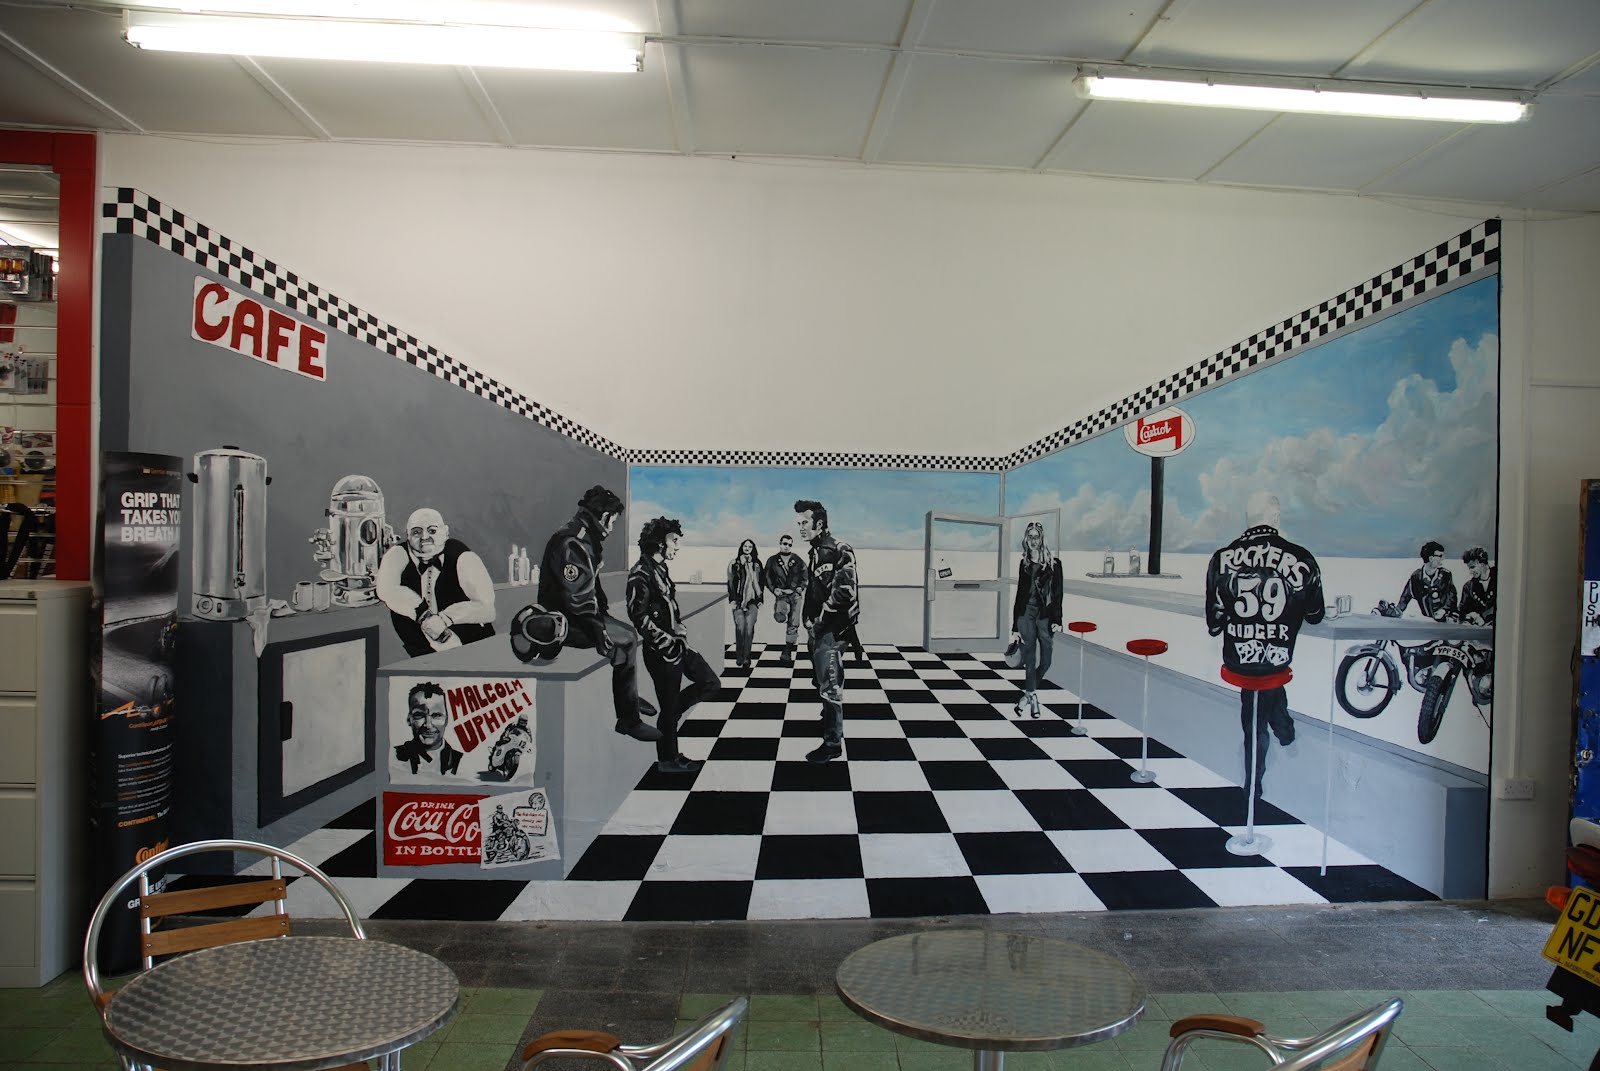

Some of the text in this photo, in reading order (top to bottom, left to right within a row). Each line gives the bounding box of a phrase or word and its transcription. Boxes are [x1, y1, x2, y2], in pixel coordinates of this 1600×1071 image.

[195, 283, 325, 378] CAFE
[1140, 421, 1172, 442] Castrol
[121, 492, 180, 508] GRIP THAT
[121, 509, 167, 524] TAKES
[121, 526, 174, 542] BREATH
[1220, 542, 1310, 591] ROCKERS
[1234, 577, 1287, 622] 59
[1585, 581, 1599, 627] PUSH
[447, 678, 523, 721] MALCOLM
[519, 740, 527, 749] 12
[420, 801, 455, 809] DRINK
[395, 845, 482, 856] IN BOTTL
[1558, 926, 1600, 973] NF
